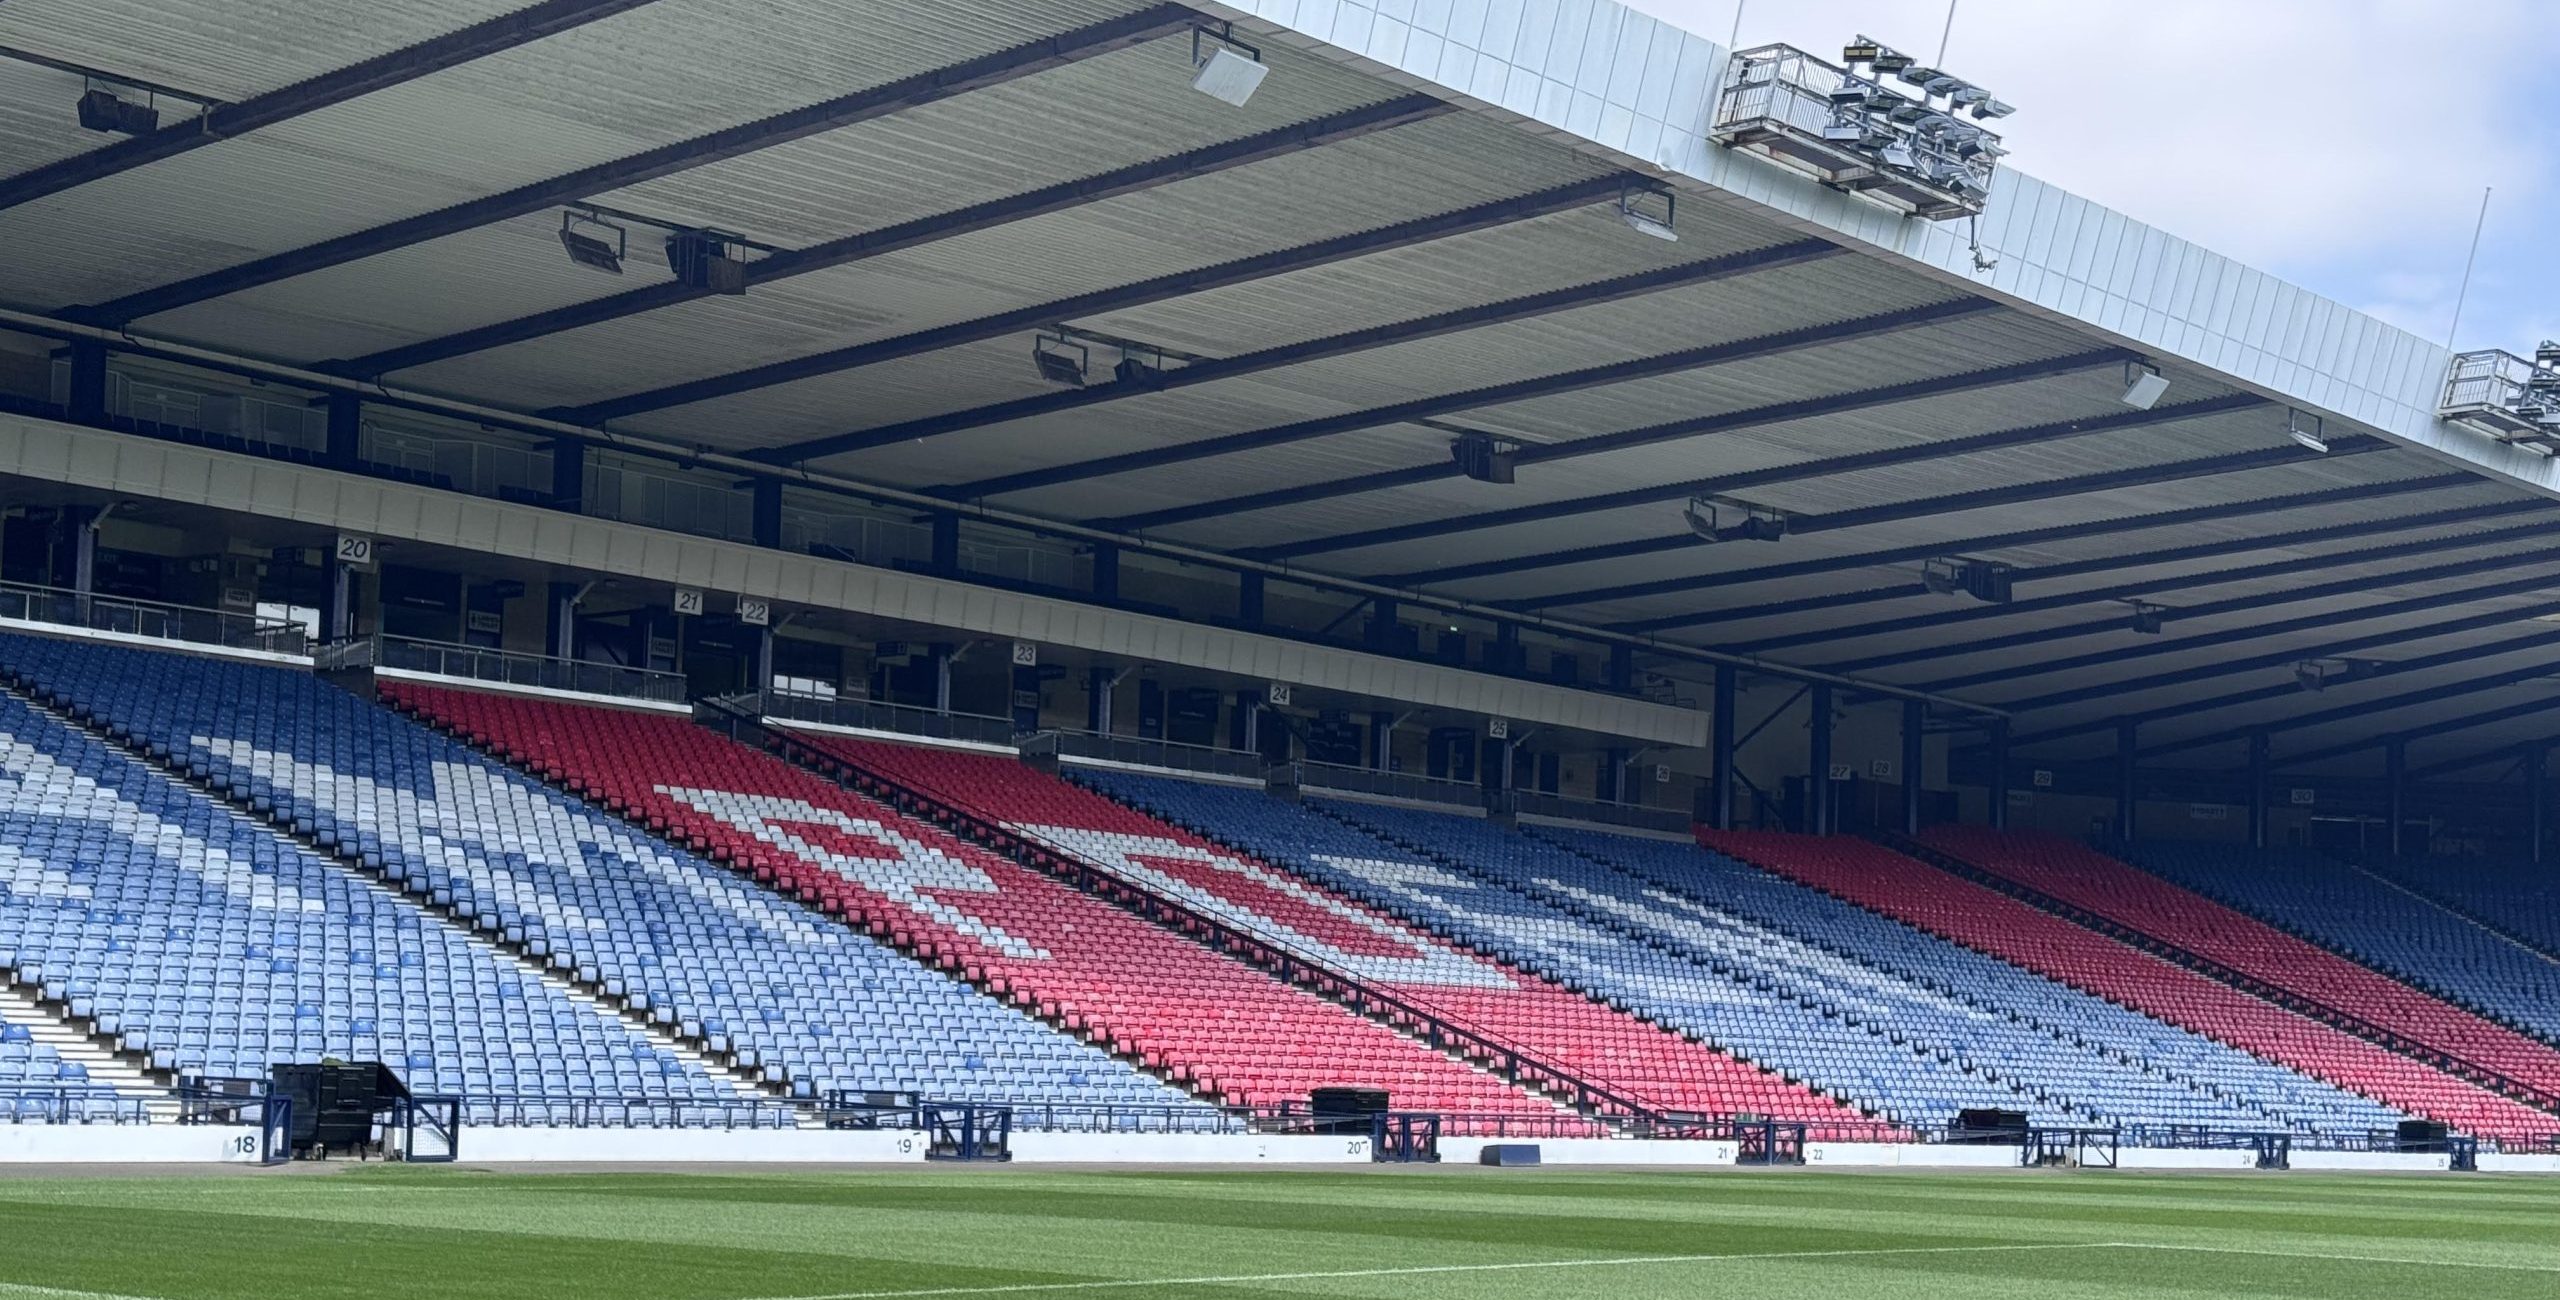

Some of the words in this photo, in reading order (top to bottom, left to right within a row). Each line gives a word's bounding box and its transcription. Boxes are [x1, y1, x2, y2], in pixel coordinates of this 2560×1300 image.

[341, 538, 368, 559] 20
[680, 593, 698, 610] 21
[745, 603, 766, 620] 22
[1016, 646, 1034, 662] 23
[1272, 686, 1288, 702] 24
[1491, 721, 1506, 736] 25
[1831, 765, 1849, 778] 27
[234, 1136, 255, 1154] 18
[897, 1138, 912, 1153] 19
[1347, 1141, 1361, 1154] 20
[1717, 1147, 1727, 1159] 21
[1813, 1148, 1823, 1160] 22
